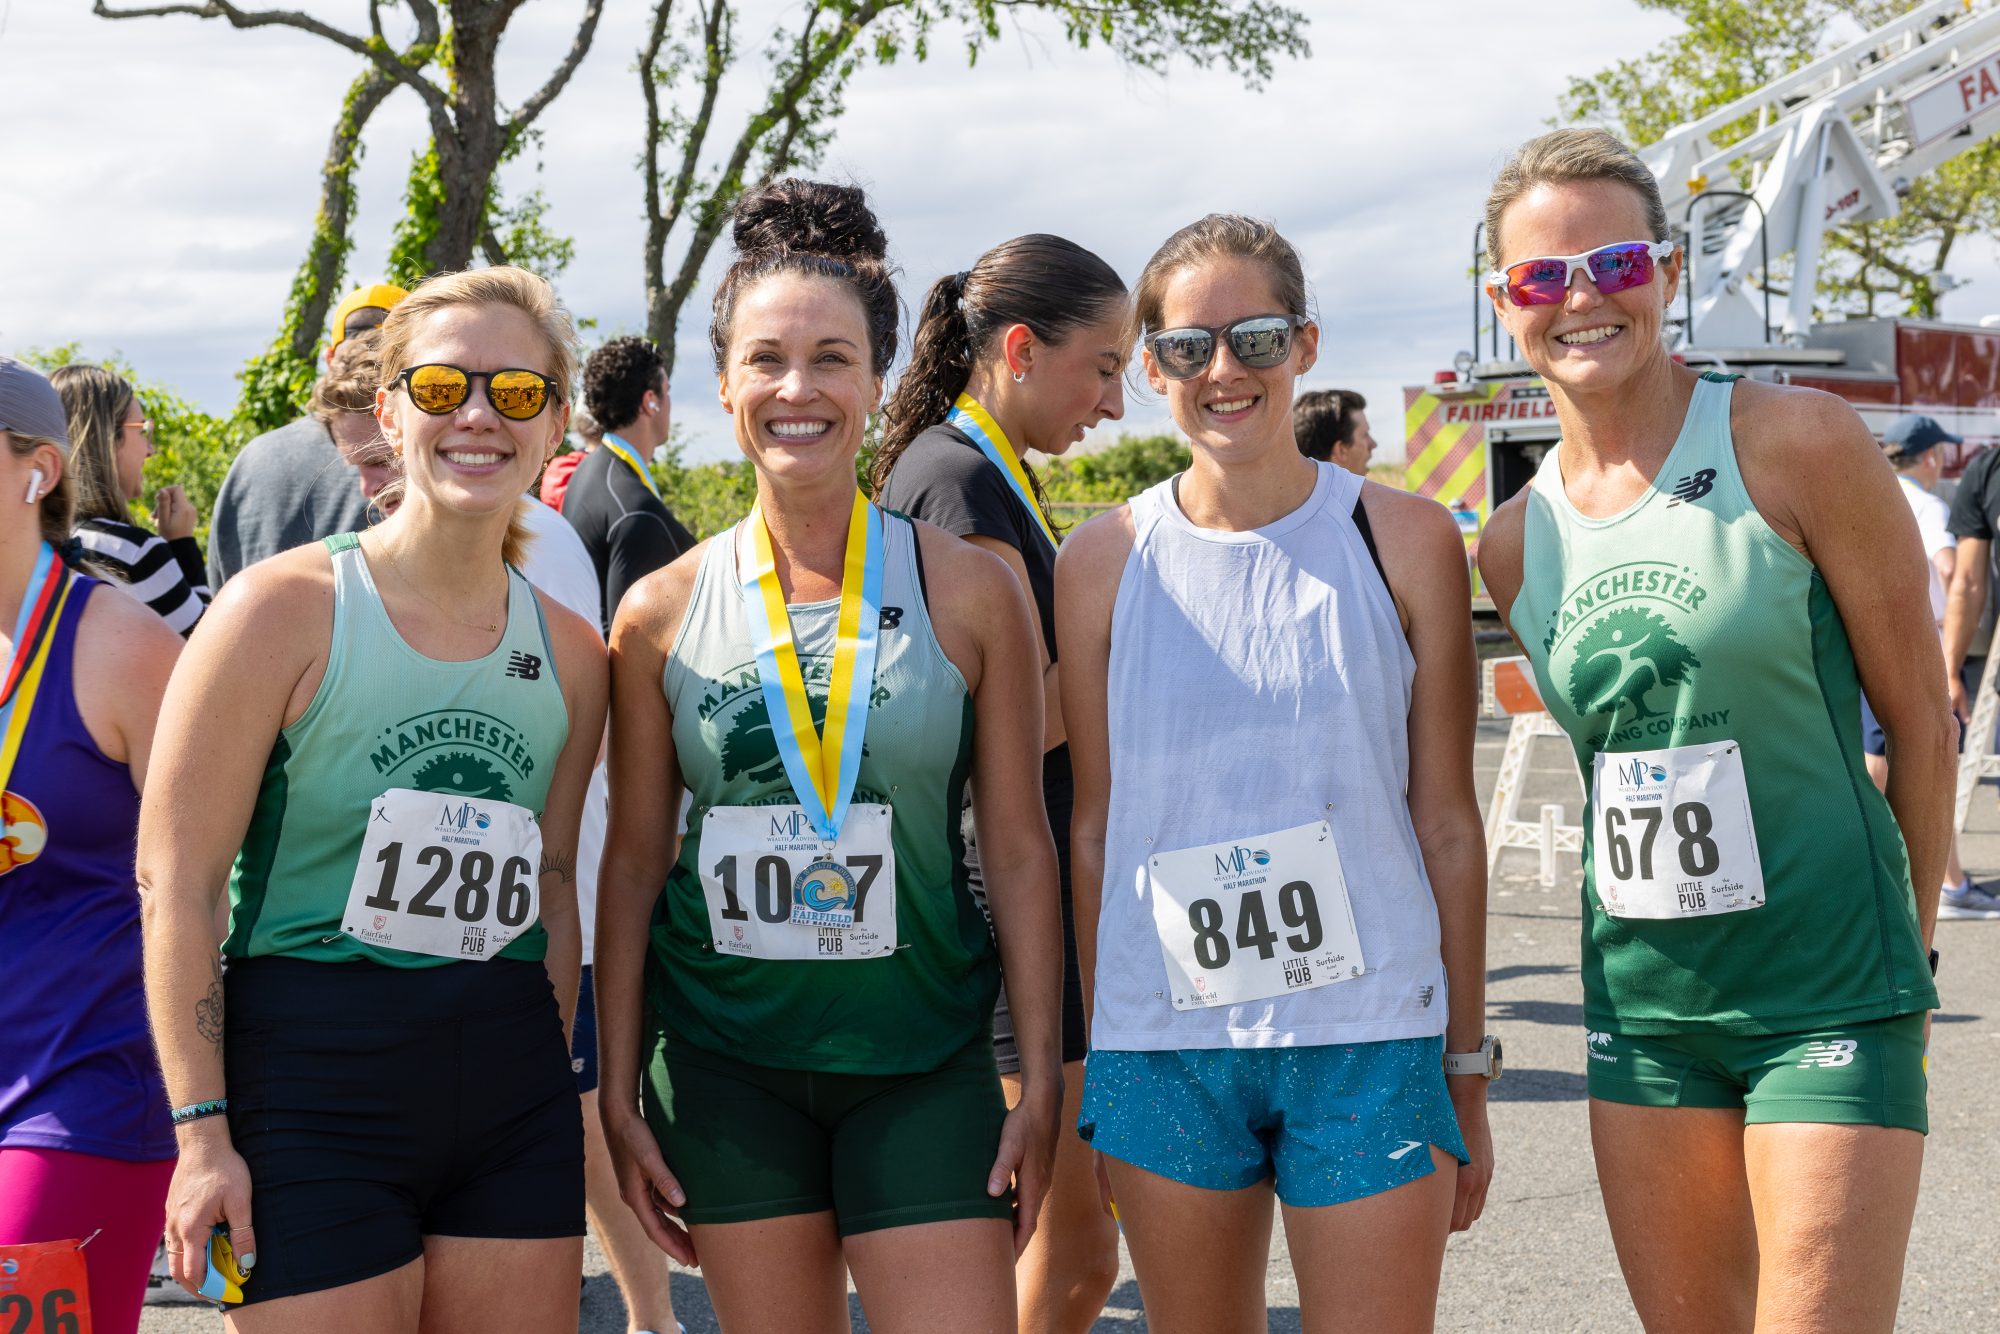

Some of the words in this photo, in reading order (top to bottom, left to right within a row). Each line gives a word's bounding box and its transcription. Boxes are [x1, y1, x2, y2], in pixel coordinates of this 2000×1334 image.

[1959, 59, 2000, 112] FA
[1447, 401, 1556, 422] FAIRFIELD
[1542, 570, 1708, 656] MANCHESTER
[369, 717, 535, 780] MANCHESTER
[1618, 758, 1649, 793] MJP
[439, 802, 477, 834] MJP
[770, 810, 808, 842] MJP
[441, 835, 454, 843] HALF
[454, 836, 480, 846] MARATHON
[1605, 801, 1720, 881] 678
[1214, 846, 1251, 880] MJP
[364, 841, 532, 928] 1286
[714, 854, 883, 924] 107
[1223, 882, 1236, 890] HALF
[1237, 876, 1266, 888] MARATHON
[1677, 881, 1703, 893] LITTLE
[1711, 882, 1744, 894] Surfside
[1679, 892, 1706, 909] PUB
[792, 910, 852, 924] FAIRFIELD
[812, 921, 851, 929] MARATHON
[1188, 880, 1323, 970] 849
[361, 928, 392, 940] Fairfield
[463, 926, 487, 937] LITTLE
[817, 927, 843, 937] LITTLE
[849, 933, 879, 941] Surfside
[461, 936, 485, 952] PUB
[818, 938, 843, 952] PUB
[1282, 956, 1309, 970] LITTLE
[1315, 954, 1344, 967] Surfside
[1284, 966, 1312, 986] PUB
